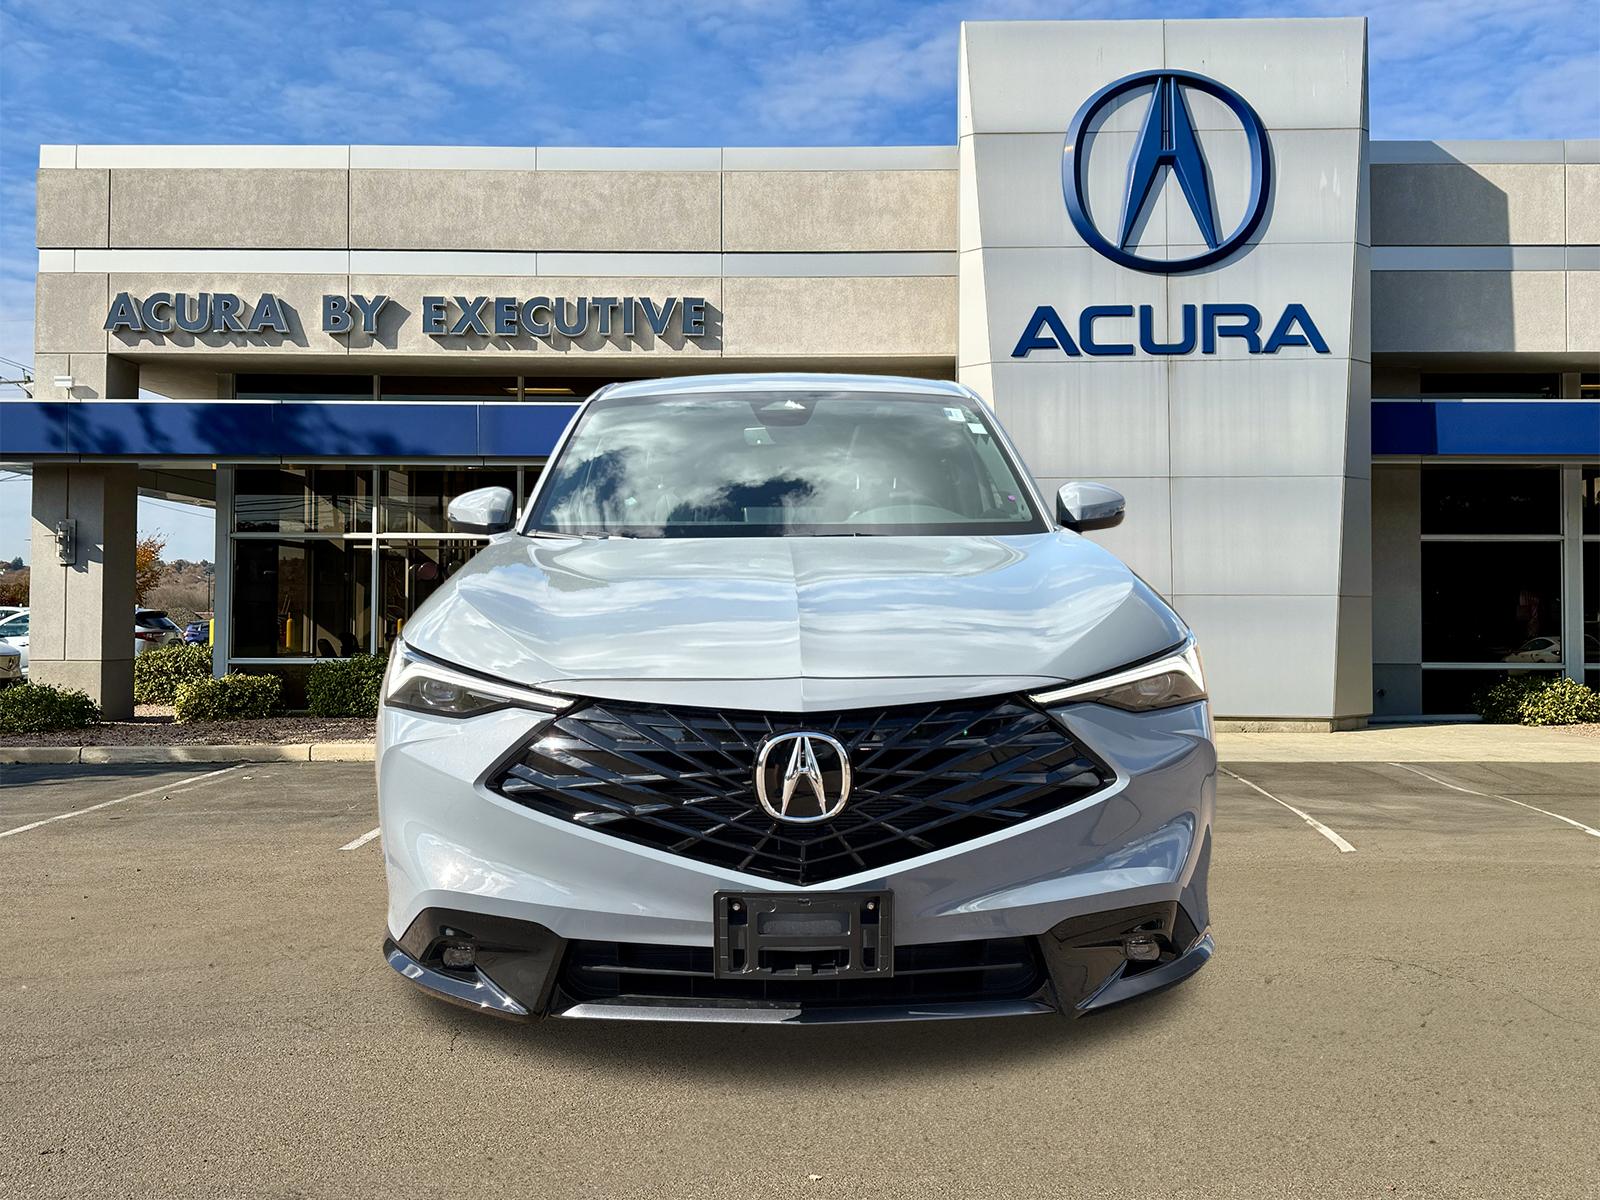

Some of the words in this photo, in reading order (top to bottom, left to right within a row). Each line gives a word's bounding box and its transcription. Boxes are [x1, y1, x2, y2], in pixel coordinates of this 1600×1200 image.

[104, 292, 289, 335] ACURA
[322, 295, 390, 335] BY
[422, 296, 707, 338] EXECUTIVE
[1011, 303, 1331, 357] ACURA
